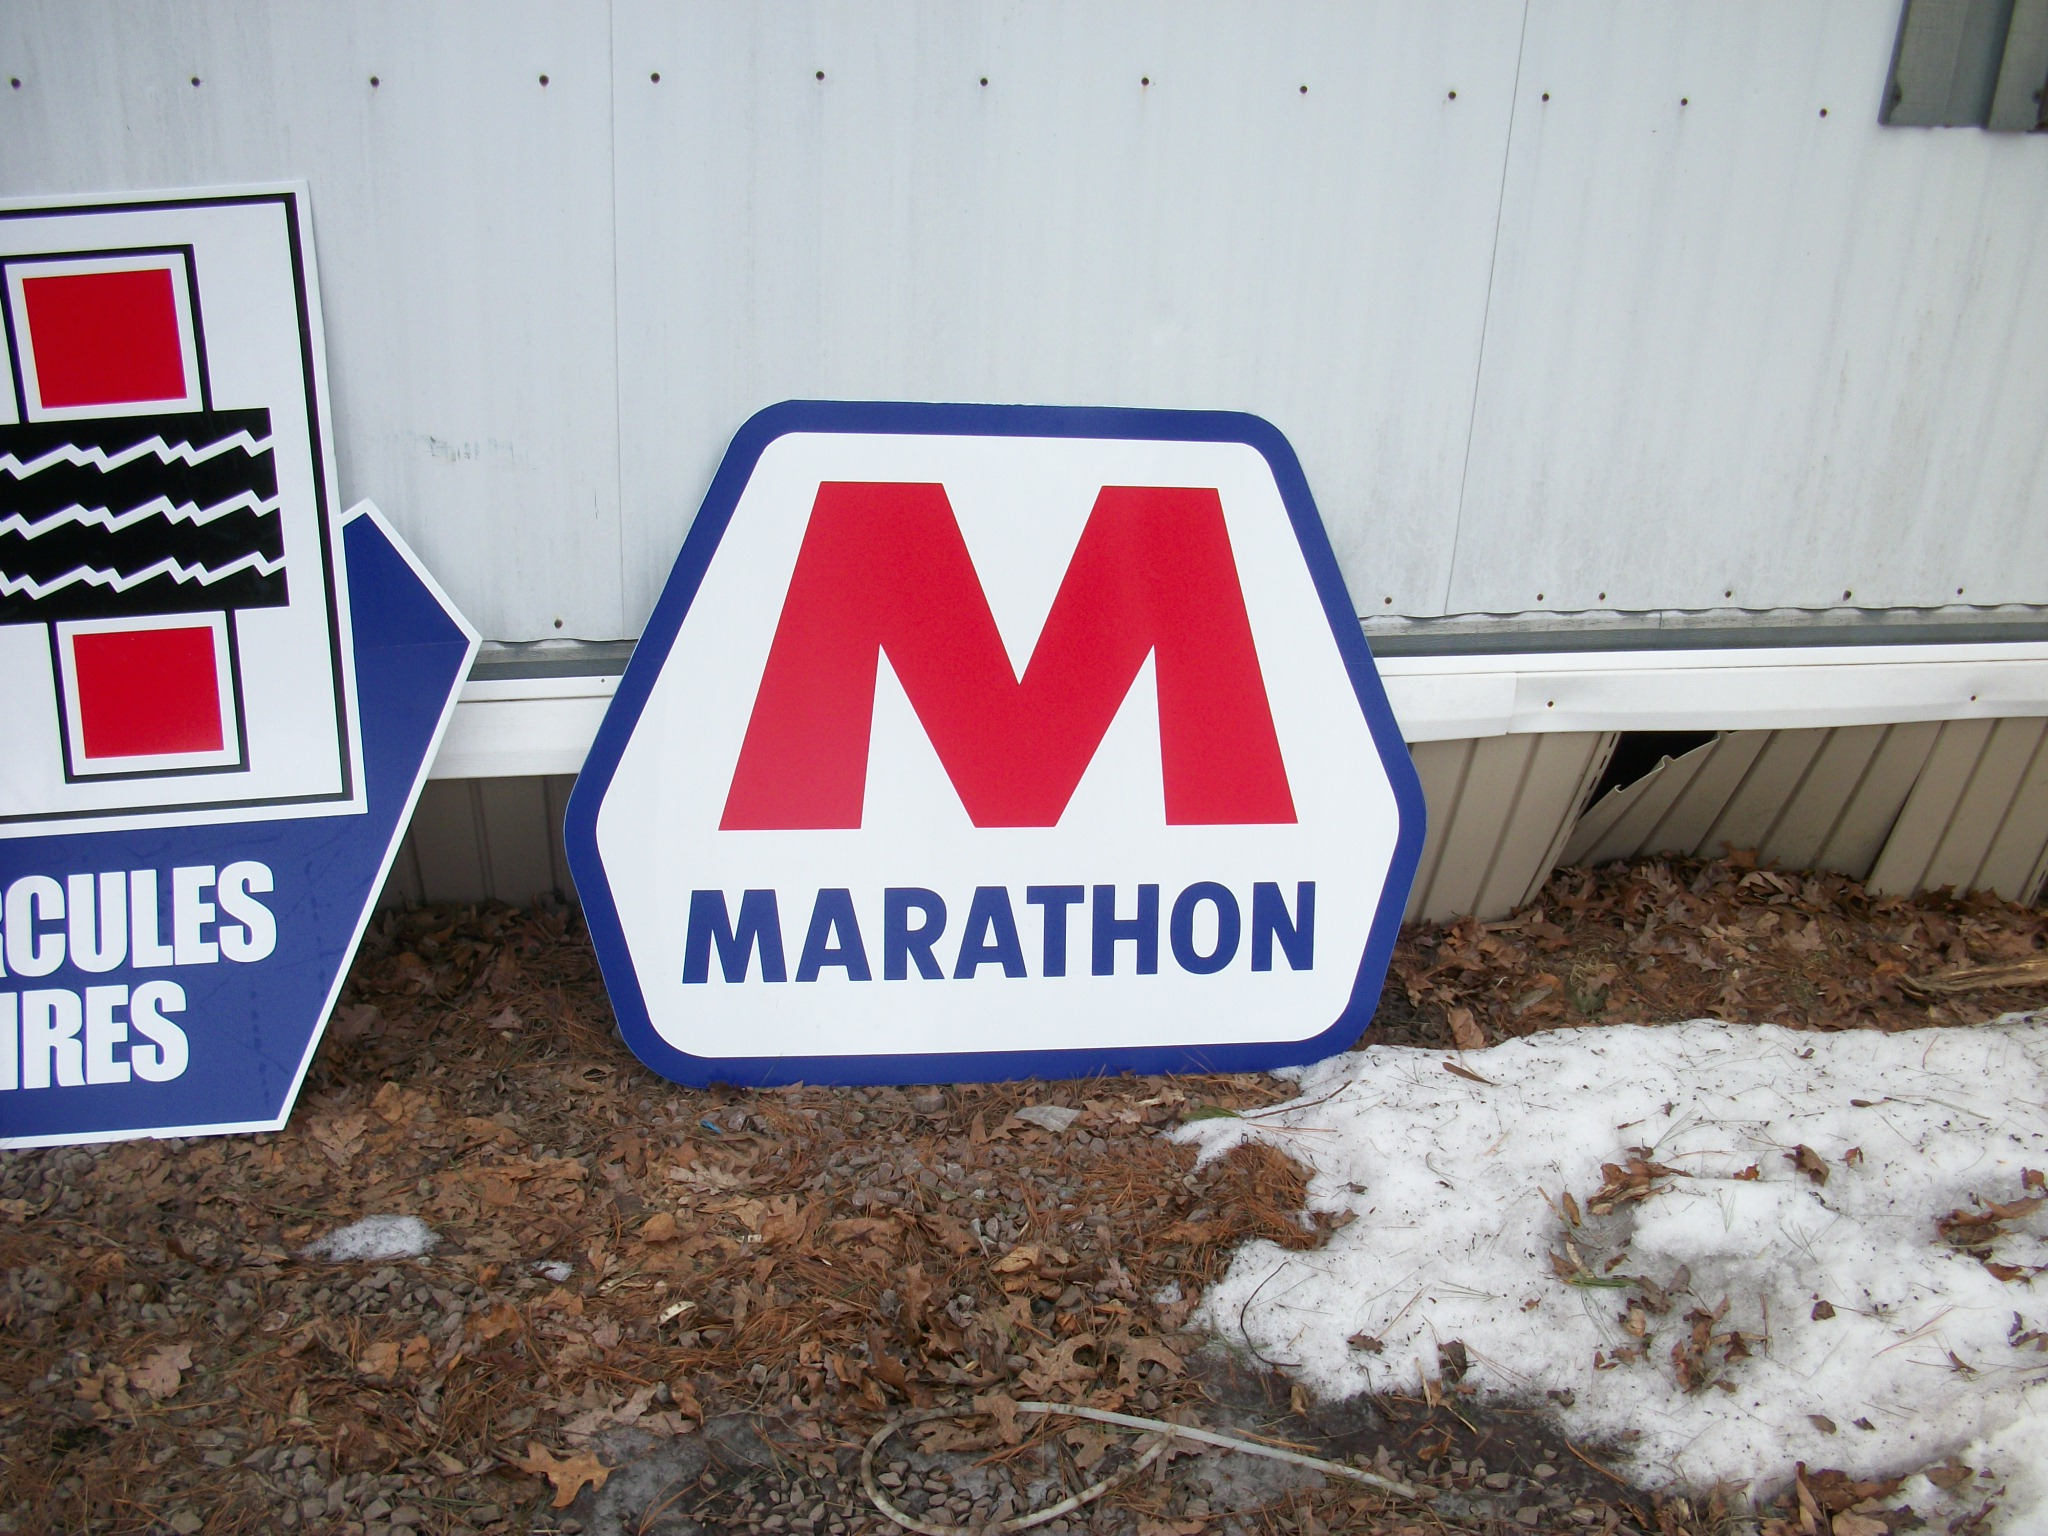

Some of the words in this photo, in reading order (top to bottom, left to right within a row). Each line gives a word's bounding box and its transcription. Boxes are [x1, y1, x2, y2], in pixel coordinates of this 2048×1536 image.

[718, 481, 1298, 830] M
[0, 860, 277, 978] CULES
[682, 881, 1316, 984] MARATHON
